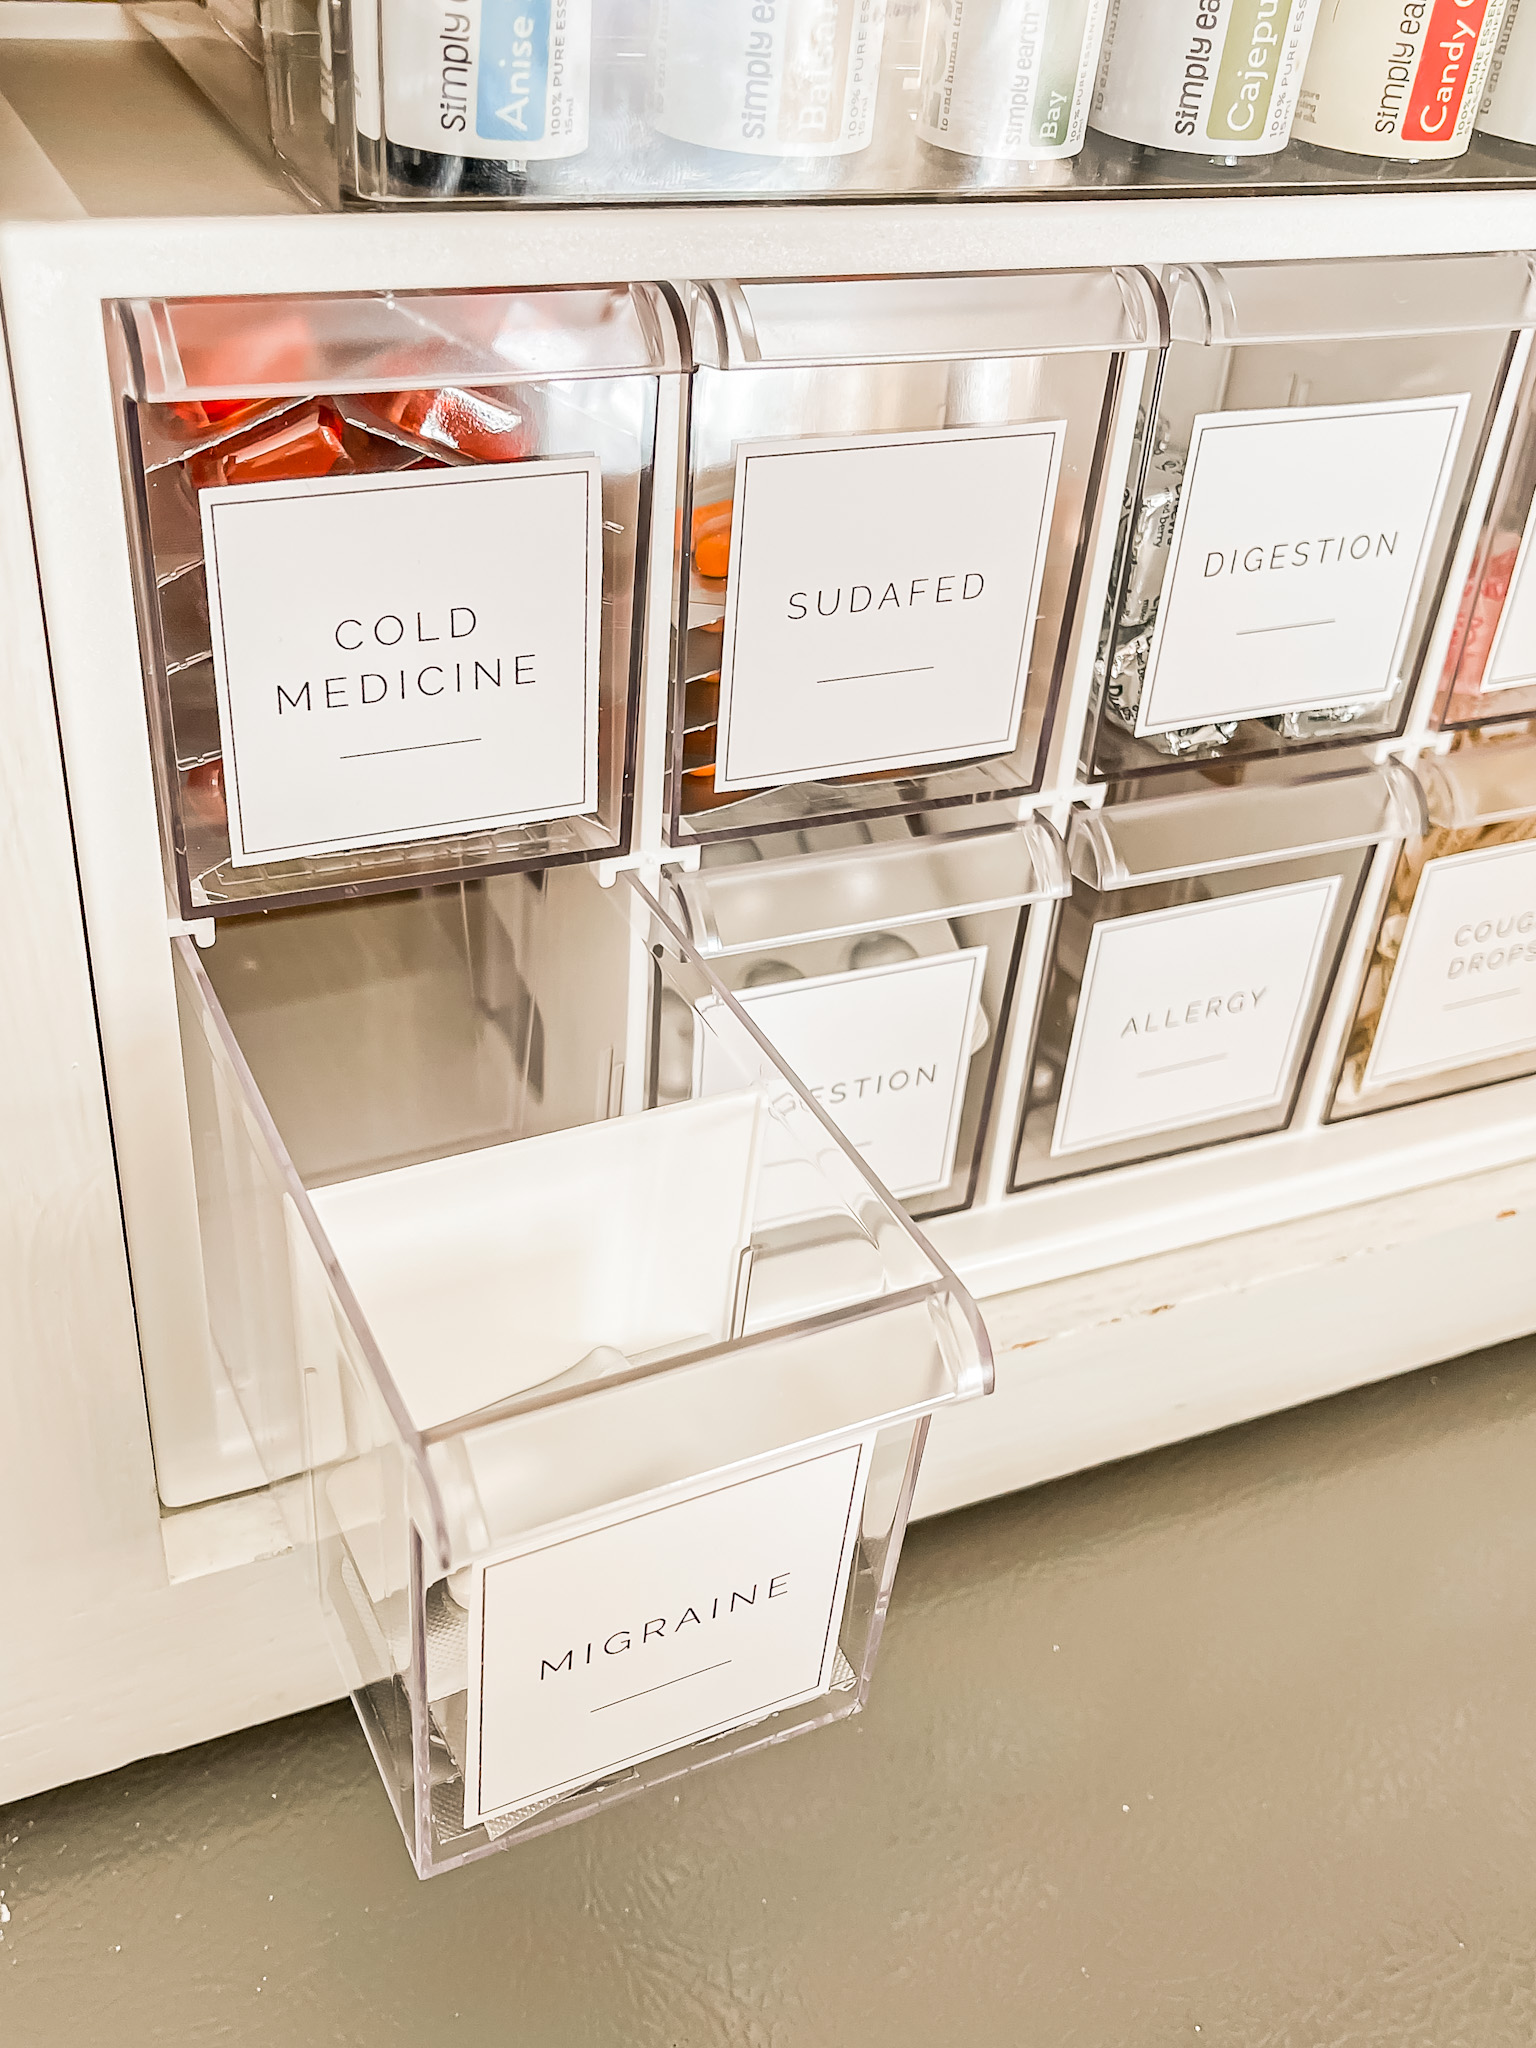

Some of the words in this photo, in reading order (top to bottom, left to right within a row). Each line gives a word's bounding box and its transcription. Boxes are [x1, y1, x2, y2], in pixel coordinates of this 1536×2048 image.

[440, 13, 472, 132] simply
[495, 16, 535, 132] Anise
[553, 37, 565, 87] PURE
[853, 31, 868, 82] PURE
[945, 31, 960, 84] human
[1227, 0, 1279, 132] Cajepu
[1420, 19, 1476, 133] Candy
[741, 31, 774, 139] simply
[944, 88, 953, 114] end
[1005, 73, 1030, 147] simply
[1069, 109, 1081, 143] 100%
[1076, 72, 1087, 106] PURE
[1174, 37, 1213, 136] simply
[1269, 91, 1287, 138] 100%
[1281, 39, 1299, 86] PURE
[1375, 42, 1415, 133] simply
[1456, 100, 1472, 136] 100%
[1467, 51, 1485, 95] PURE
[1480, 99, 1491, 115] to
[551, 92, 562, 137] 100%
[847, 89, 861, 139] 100%
[940, 119, 949, 131] to
[1039, 91, 1067, 139] Bay
[1279, 99, 1292, 136] 15ml
[1203, 531, 1398, 578] DIGESTION
[787, 573, 985, 620] SUDAFED
[335, 607, 477, 650] COLD
[277, 654, 537, 715] MEDICINE
[1120, 986, 1268, 1039] ALLERGY
[540, 1572, 791, 1681] MIGRAINE
